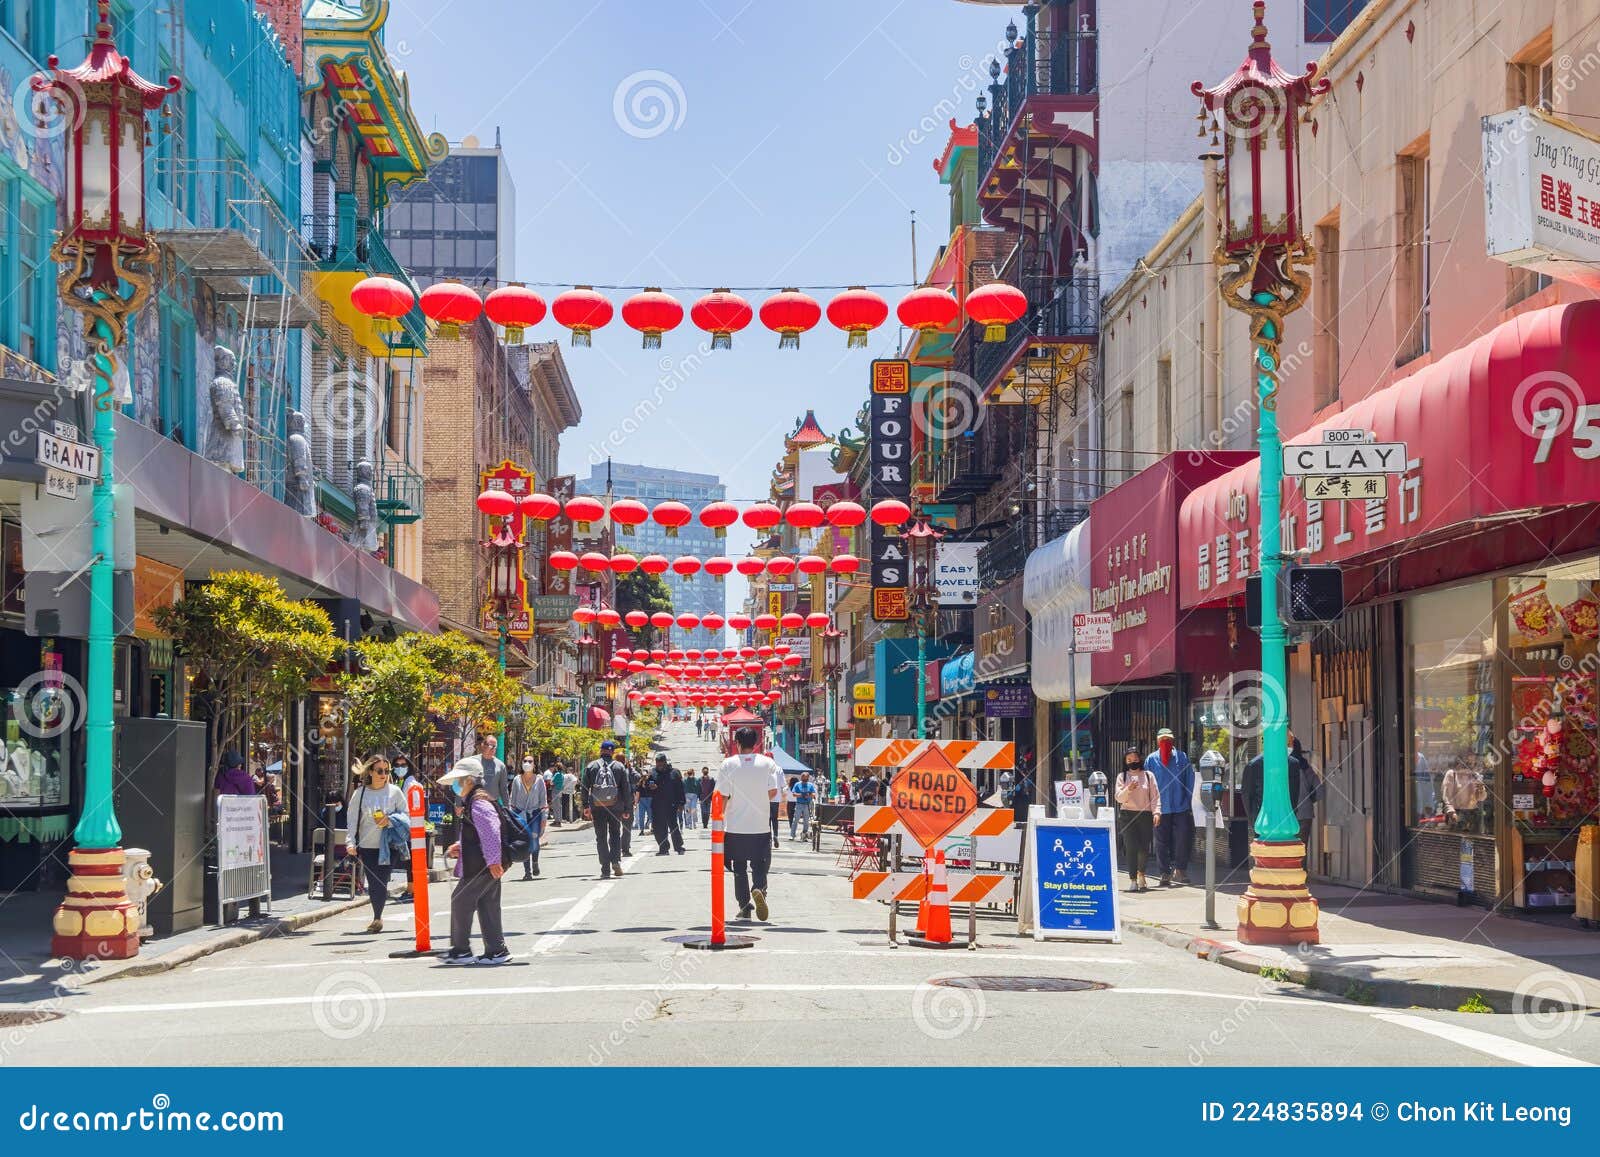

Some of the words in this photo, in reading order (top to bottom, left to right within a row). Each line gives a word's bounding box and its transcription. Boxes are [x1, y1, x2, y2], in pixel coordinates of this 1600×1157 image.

[1534, 136, 1558, 168] Jing
[1562, 146, 1584, 180] Ying
[1538, 215, 1562, 232] SPECIALIZE
[1568, 228, 1587, 241] NATURAL
[880, 397, 903, 482] FOUR
[1328, 431, 1350, 441] 800
[44, 438, 95, 472] GRANT
[1297, 448, 1394, 469] CLAY
[1314, 479, 1377, 497] 企李街
[1224, 491, 1248, 522] Jing
[1092, 580, 1120, 613] Eternity
[1120, 574, 1137, 603] Fine
[1138, 560, 1171, 597] Jewelry
[1074, 615, 1085, 626] NO
[1087, 616, 1111, 624] PARKING
[908, 771, 958, 792] ROAD
[897, 791, 967, 814] CLOSED
[1043, 881, 1062, 890] Stay
[1069, 882, 1085, 891] feet
[1085, 884, 1108, 893] apart
